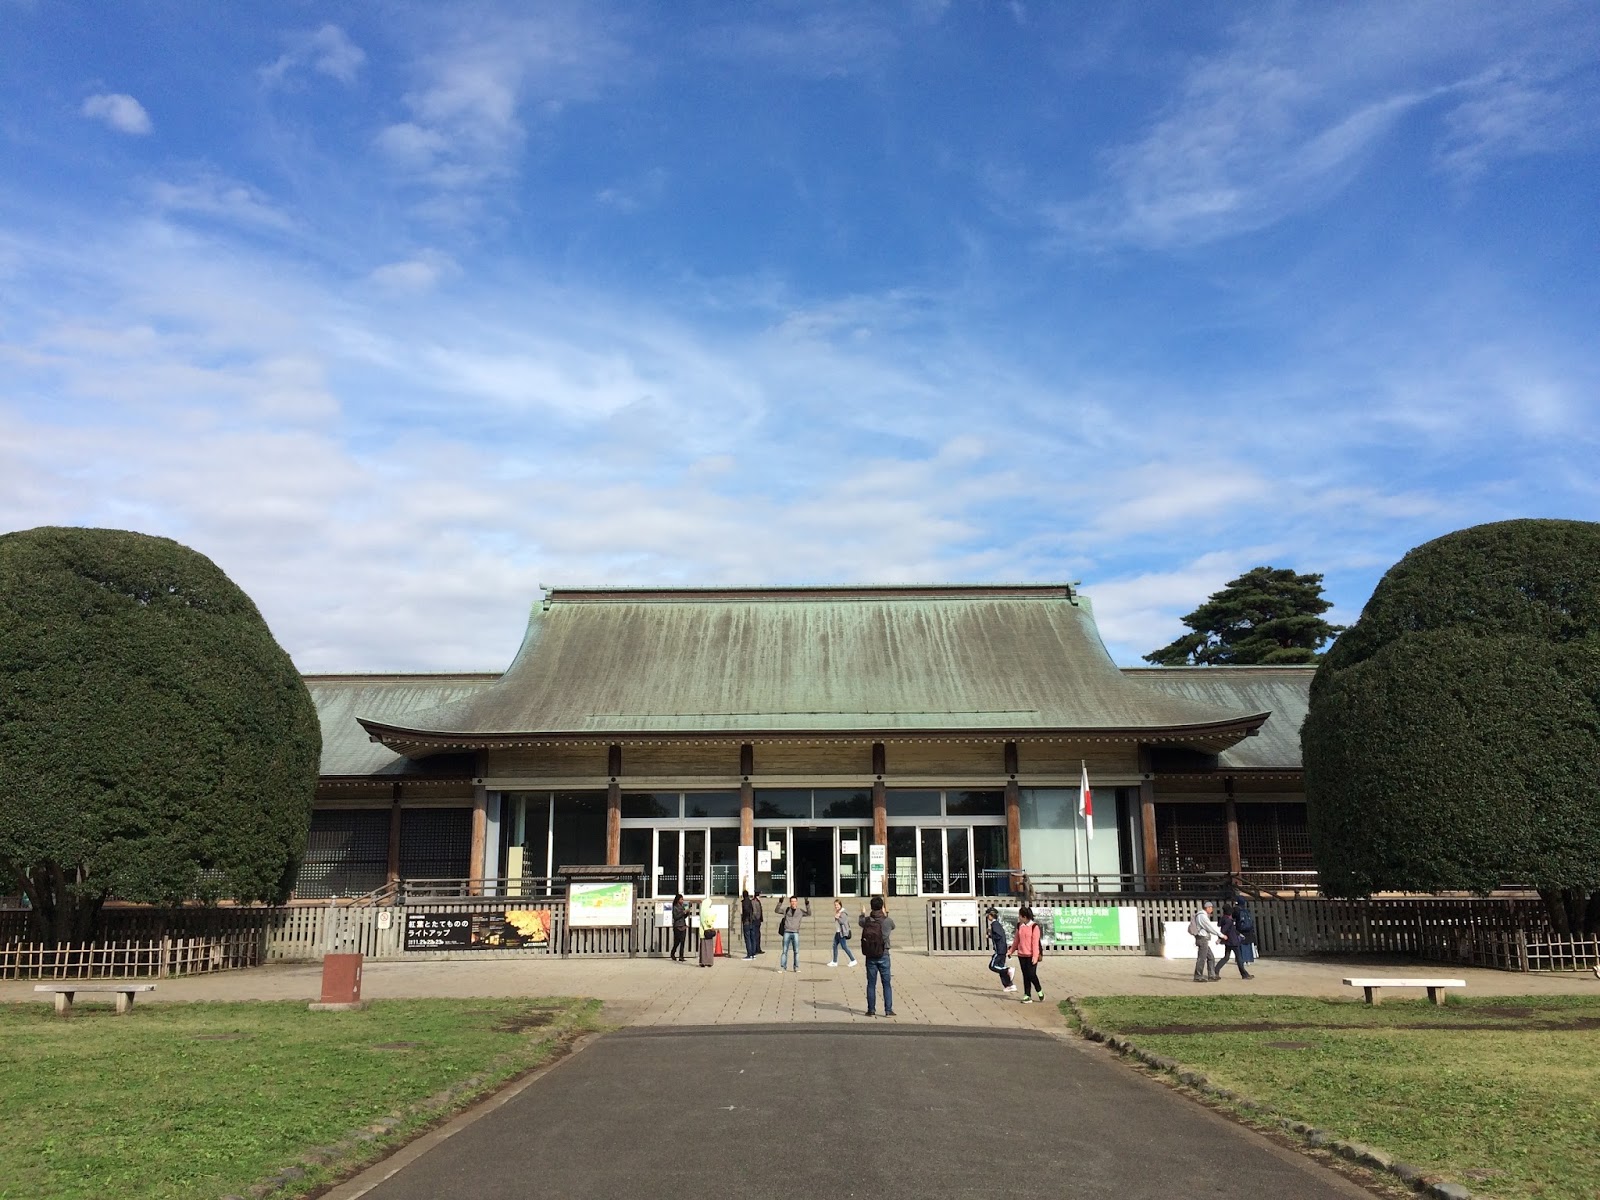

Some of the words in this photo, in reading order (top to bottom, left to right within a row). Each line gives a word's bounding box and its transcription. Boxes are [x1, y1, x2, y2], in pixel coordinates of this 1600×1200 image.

[408, 920, 469, 928] 紅葉とたてものの
[1059, 917, 1092, 925] ものがたり
[408, 929, 451, 937] ライトアップ
